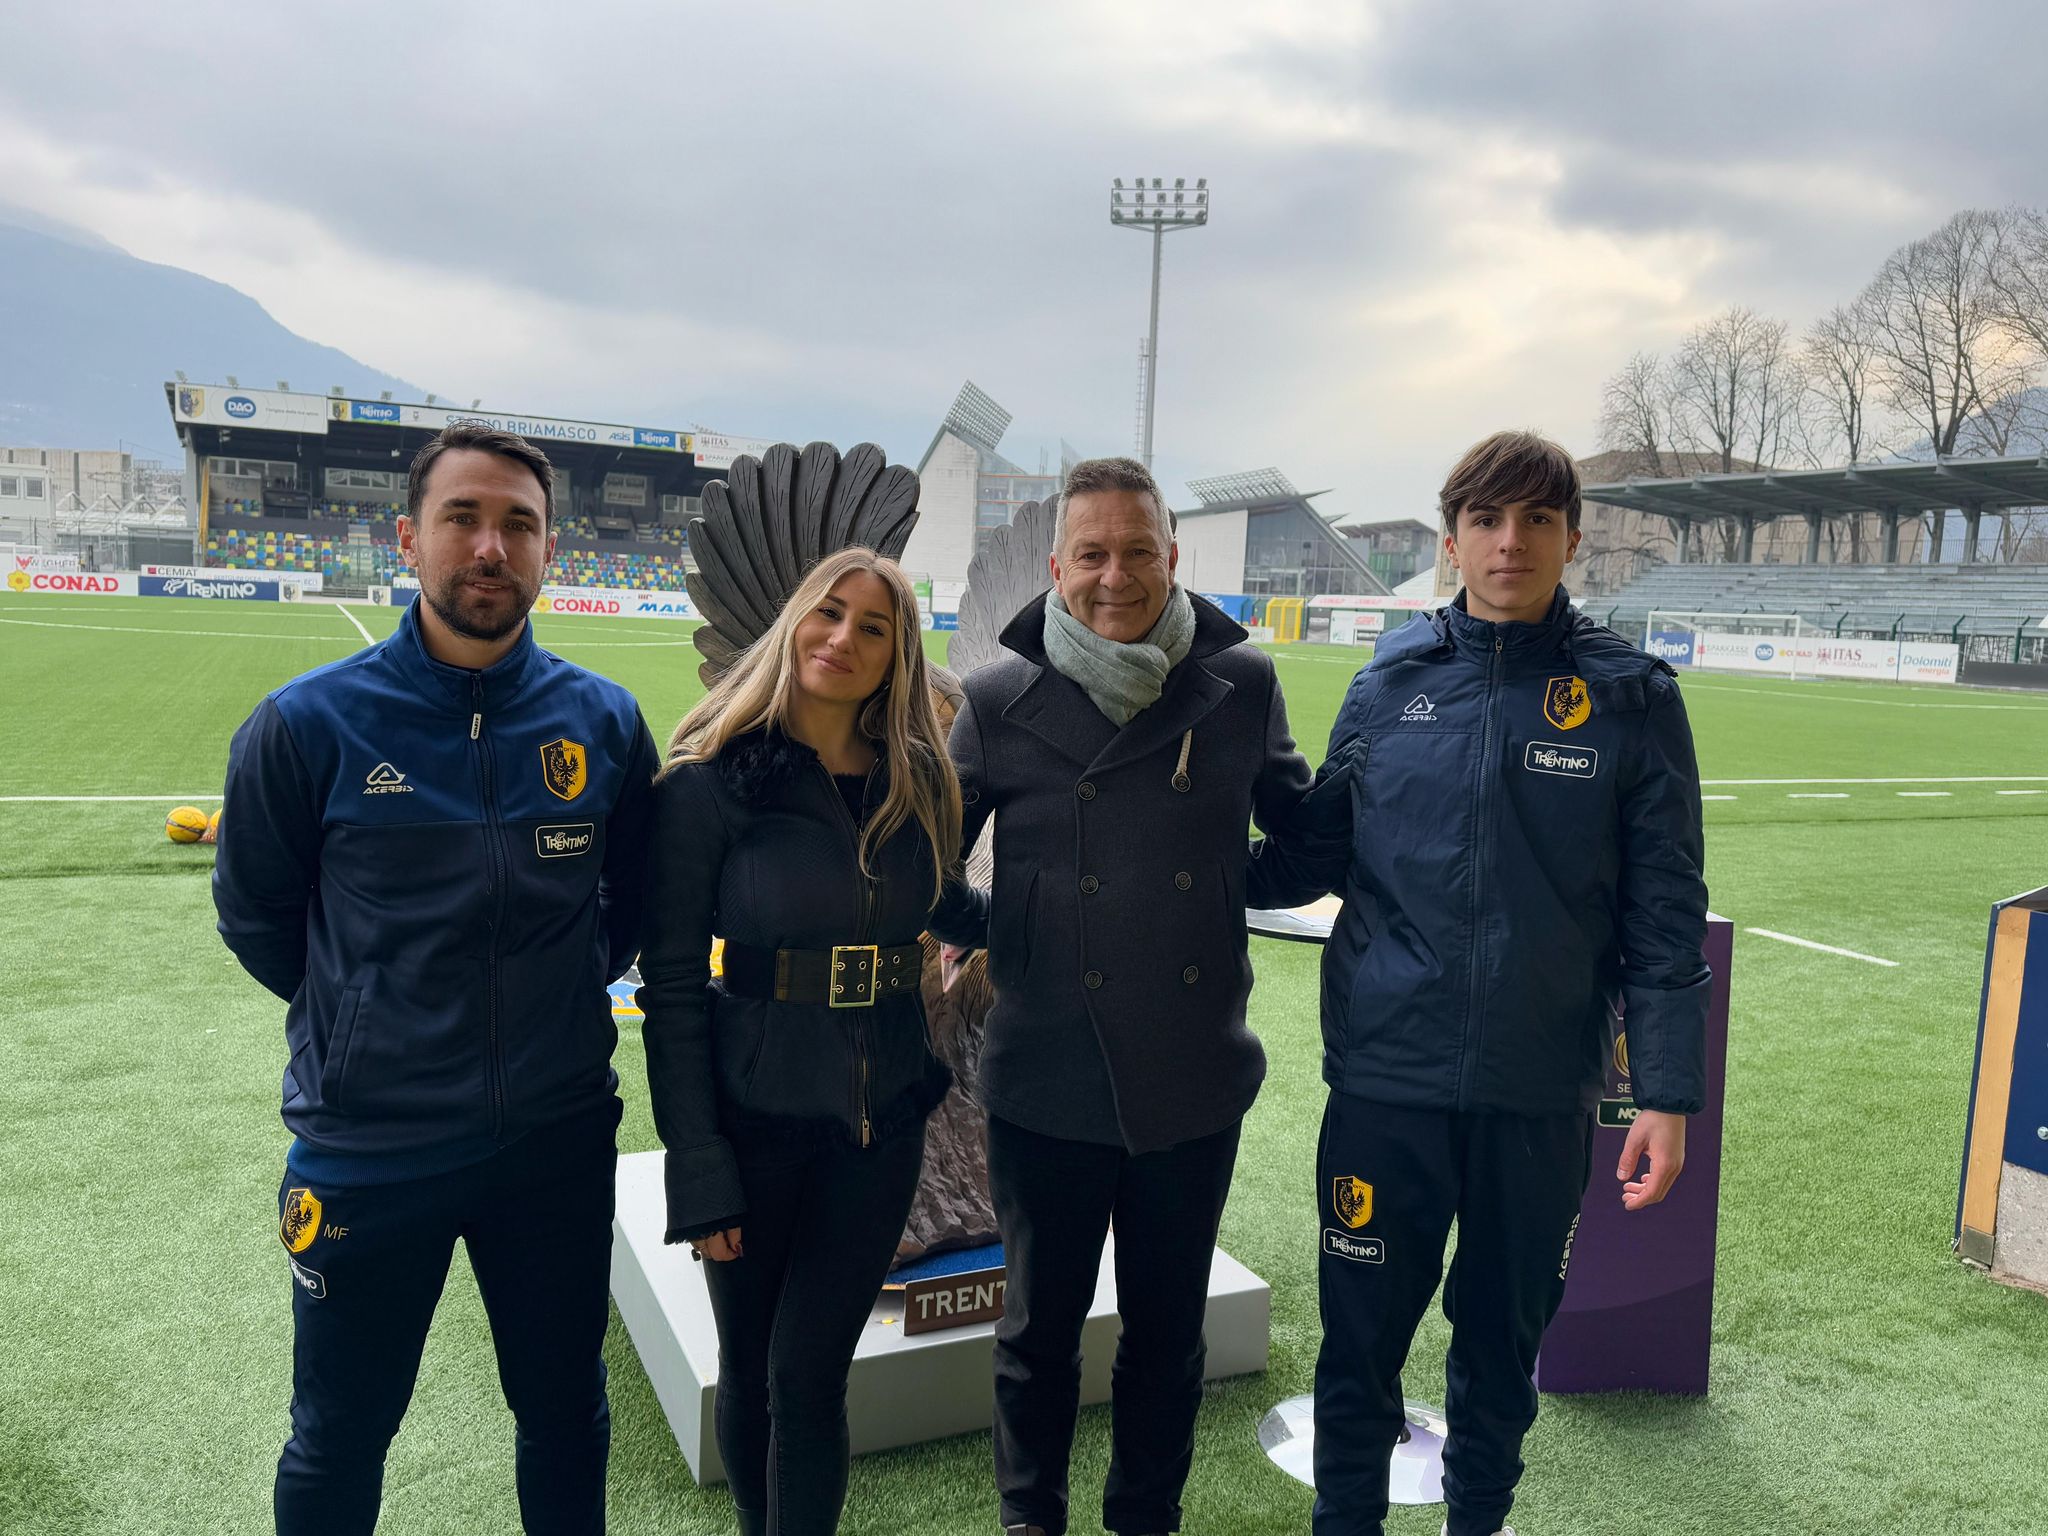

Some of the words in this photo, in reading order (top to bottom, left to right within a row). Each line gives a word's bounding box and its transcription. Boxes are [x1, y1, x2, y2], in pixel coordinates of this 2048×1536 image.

[228, 401, 254, 412] DAO
[507, 421, 597, 441] BRIAMASCO
[158, 567, 197, 577] CEMIAT
[33, 574, 119, 592] CONAD
[185, 579, 256, 598] TRENTINO
[553, 598, 620, 613] CONAD
[637, 602, 689, 613] MAK
[1834, 648, 1862, 660] ITAS
[1903, 655, 1952, 666] Dolomiti
[1918, 667, 1950, 675] energia
[1534, 750, 1589, 770] TRENTINO
[543, 834, 589, 850] TRENTINO
[324, 1224, 349, 1240] MF
[1330, 1236, 1377, 1257] TRENTINO
